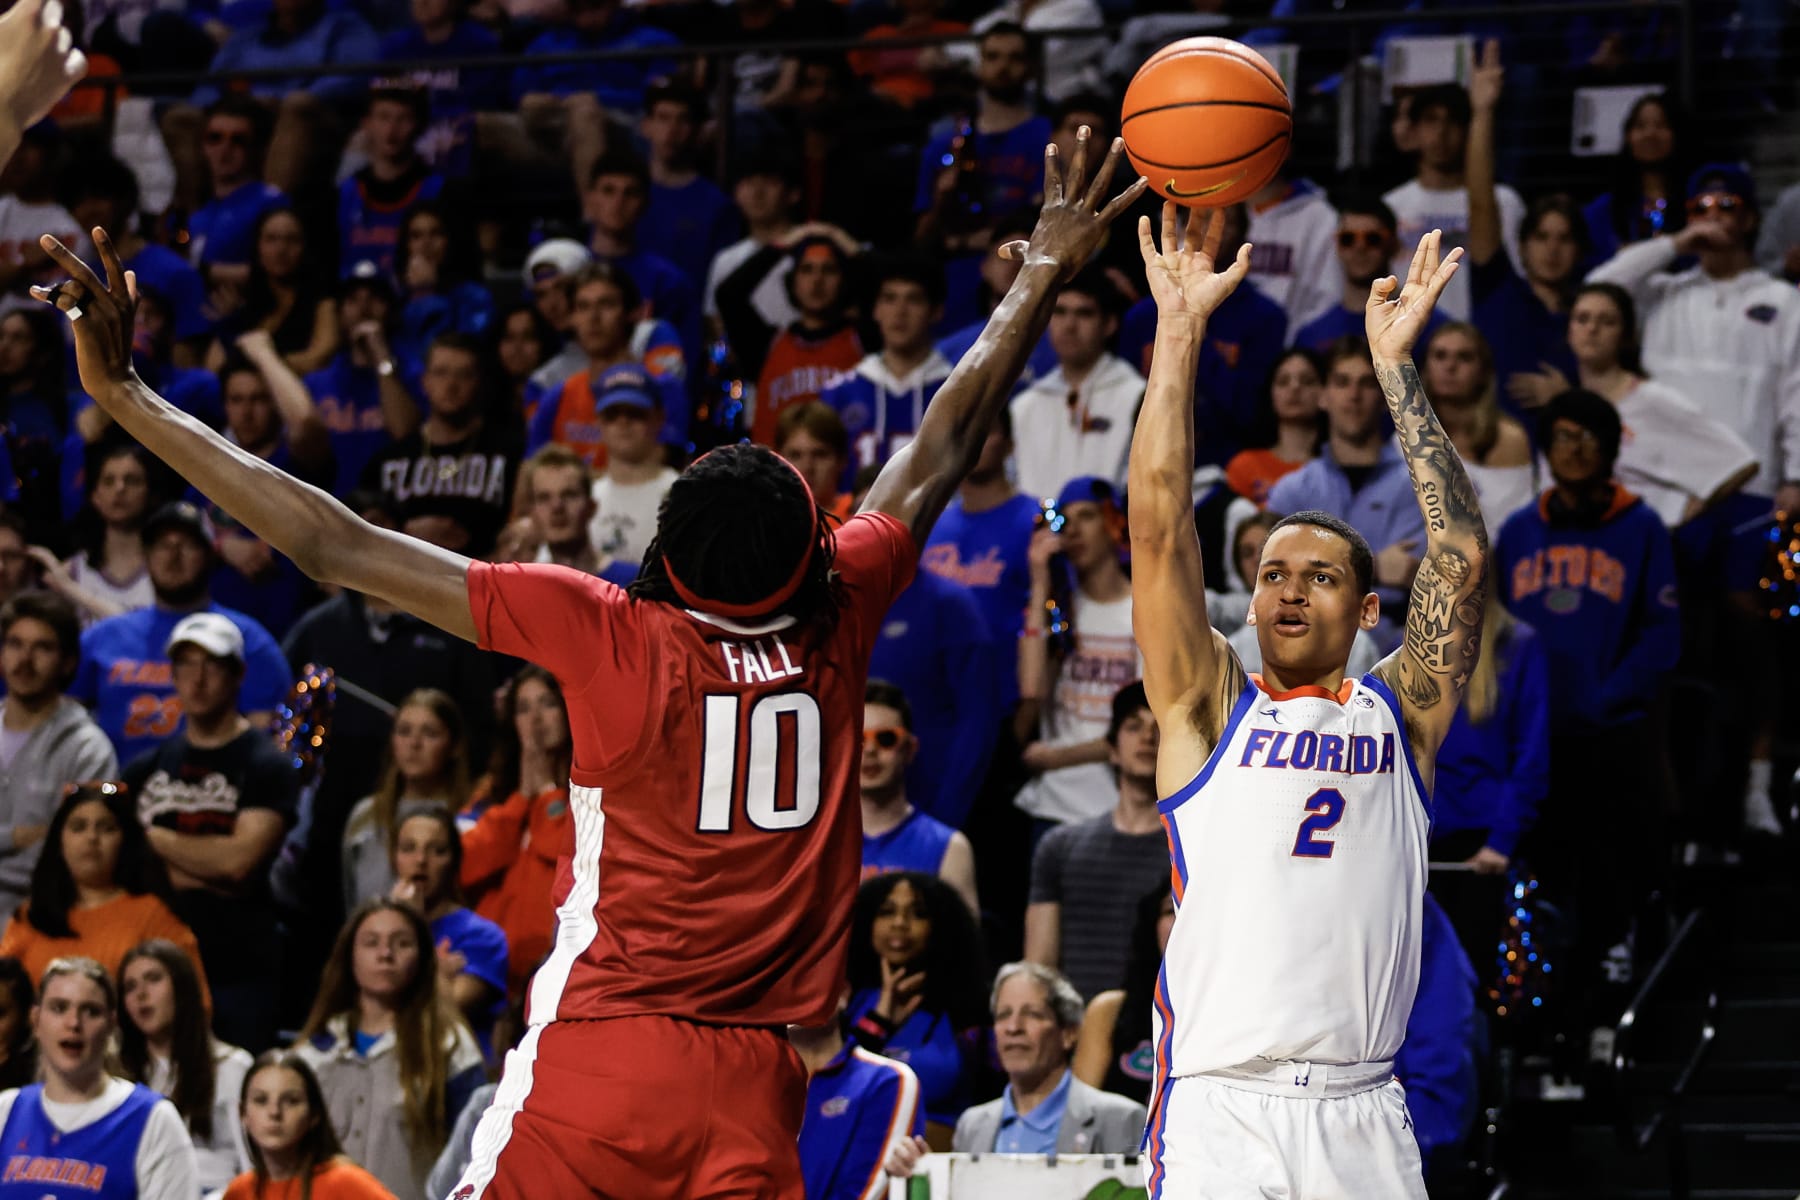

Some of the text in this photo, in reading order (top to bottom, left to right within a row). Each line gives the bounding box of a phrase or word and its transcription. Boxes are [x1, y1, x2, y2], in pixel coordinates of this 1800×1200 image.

[382, 454, 506, 502] FLORIDA
[1422, 481, 1445, 531] 2003
[721, 634, 803, 683] FALL
[697, 687, 821, 832] 10
[1238, 728, 1395, 775] FLORIDA
[1291, 788, 1347, 859] 2
[3, 1155, 107, 1192] FLORIDA
